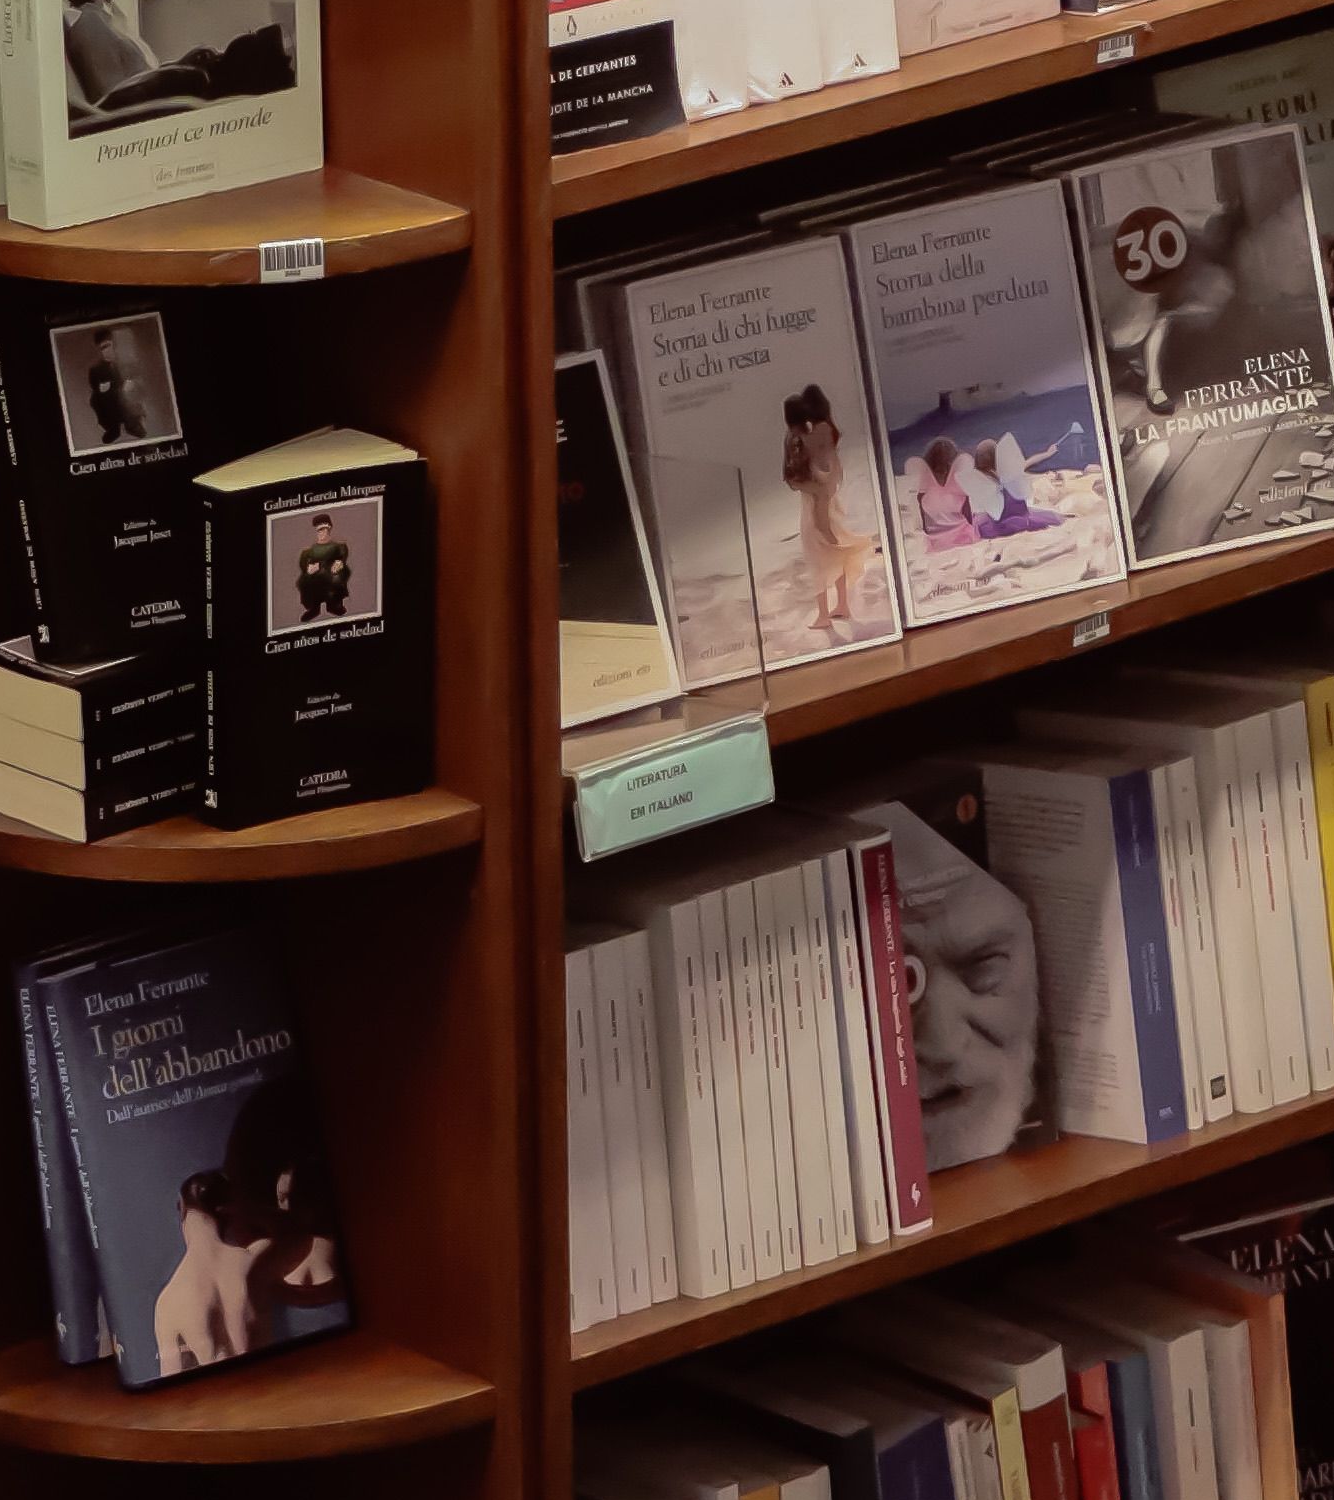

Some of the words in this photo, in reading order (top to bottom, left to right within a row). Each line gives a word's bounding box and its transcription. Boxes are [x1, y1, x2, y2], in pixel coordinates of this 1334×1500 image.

[559, 65, 574, 82] DE
[575, 53, 638, 79] CERVANTES
[576, 96, 590, 110] DE
[591, 92, 605, 107] LA
[606, 81, 654, 106] MANCHA
[97, 132, 179, 163] Pourquoi
[184, 127, 205, 142] ce
[208, 107, 274, 136] monde
[871, 238, 918, 266] Elena
[922, 222, 992, 258] Ferrante
[1116, 220, 1188, 284] 30
[876, 265, 935, 299] Storia
[939, 254, 986, 283] della
[650, 299, 697, 326] Elena
[699, 283, 773, 318] Ferrante
[880, 291, 968, 331] bambina
[971, 275, 1050, 319] perduta
[653, 325, 708, 359] Storia
[710, 320, 732, 346] di
[734, 316, 763, 340] chi
[657, 370, 669, 388] e
[673, 359, 691, 383] di
[696, 352, 725, 378] chi
[727, 346, 772, 372] resta
[1244, 347, 1312, 376] ELENA
[1184, 366, 1314, 410] FERRANTE
[1134, 423, 1161, 445] LA
[1165, 388, 1320, 439] FRANTUMAGLIA
[264, 637, 291, 656] Cien
[294, 634, 320, 651] años
[322, 628, 338, 646] de
[339, 620, 385, 643] soledad
[626, 761, 689, 792] LITERATURA
[629, 804, 646, 822] EM
[648, 789, 695, 817] ITALIANO
[85, 991, 135, 1018] Elena
[137, 969, 210, 1006] Ferrante
[90, 1025, 108, 1058] I
[111, 1004, 185, 1050] giorni
[102, 1025, 293, 1103] dell'abbandono
